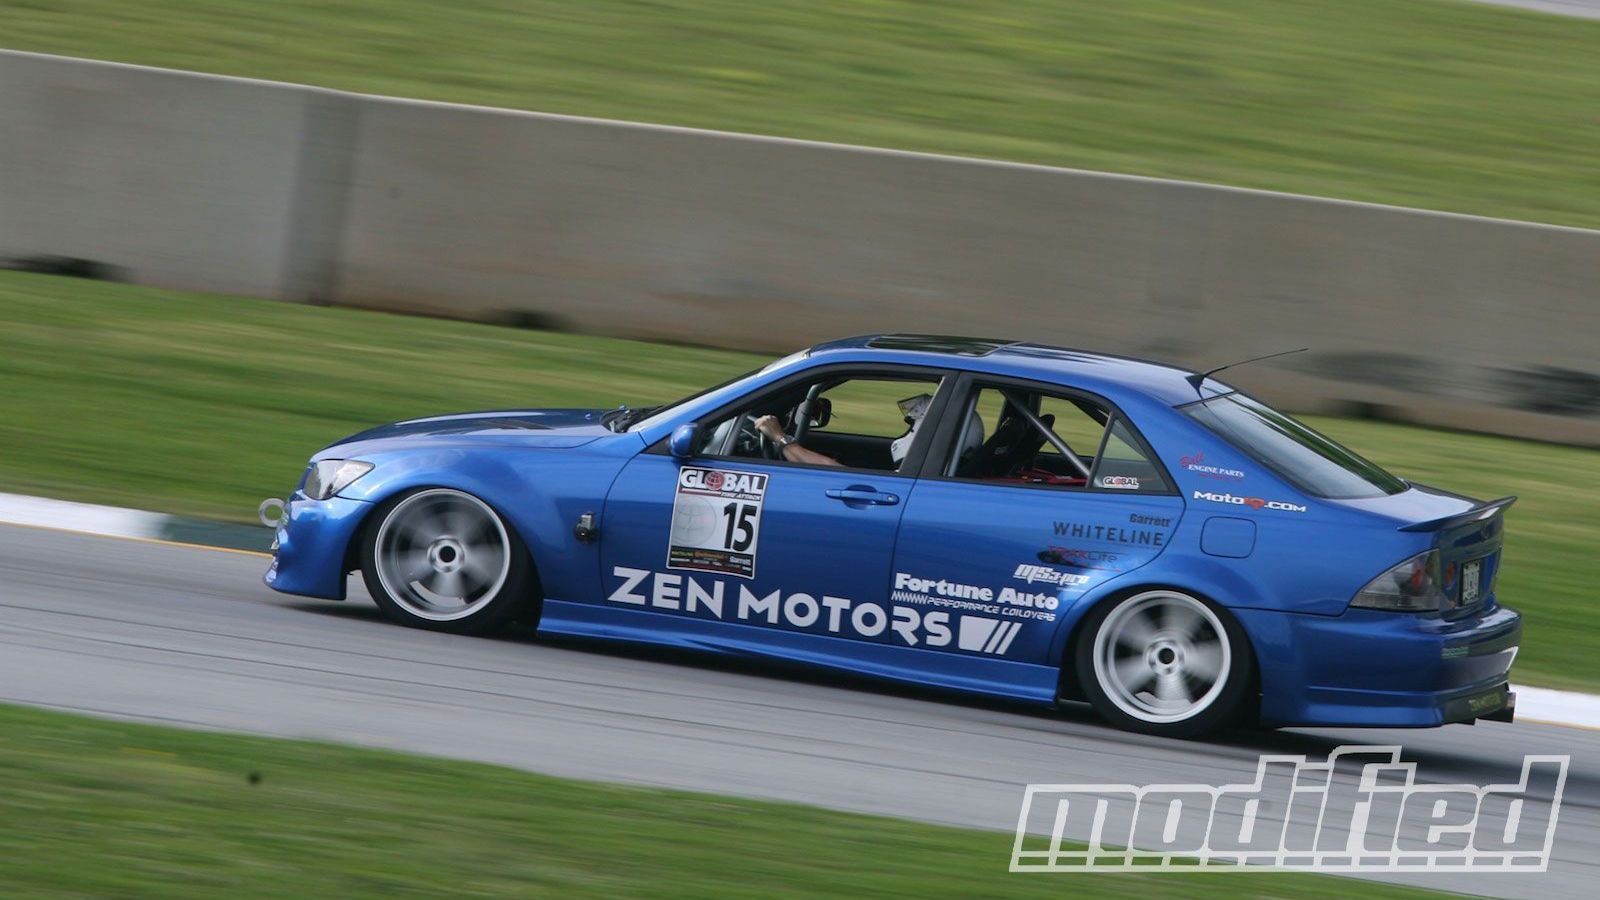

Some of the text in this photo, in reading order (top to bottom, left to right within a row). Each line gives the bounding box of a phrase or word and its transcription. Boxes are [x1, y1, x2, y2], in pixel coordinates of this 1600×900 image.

[680, 469, 763, 494] GLOBAL
[1188, 464, 1244, 478] ENGINE PARTS
[723, 502, 758, 552] 15
[1129, 513, 1171, 527] Garrett
[1053, 521, 1164, 546] WHITELINE
[895, 572, 1059, 610] Fortune Auto
[608, 566, 953, 647] ZEN MOTORS
